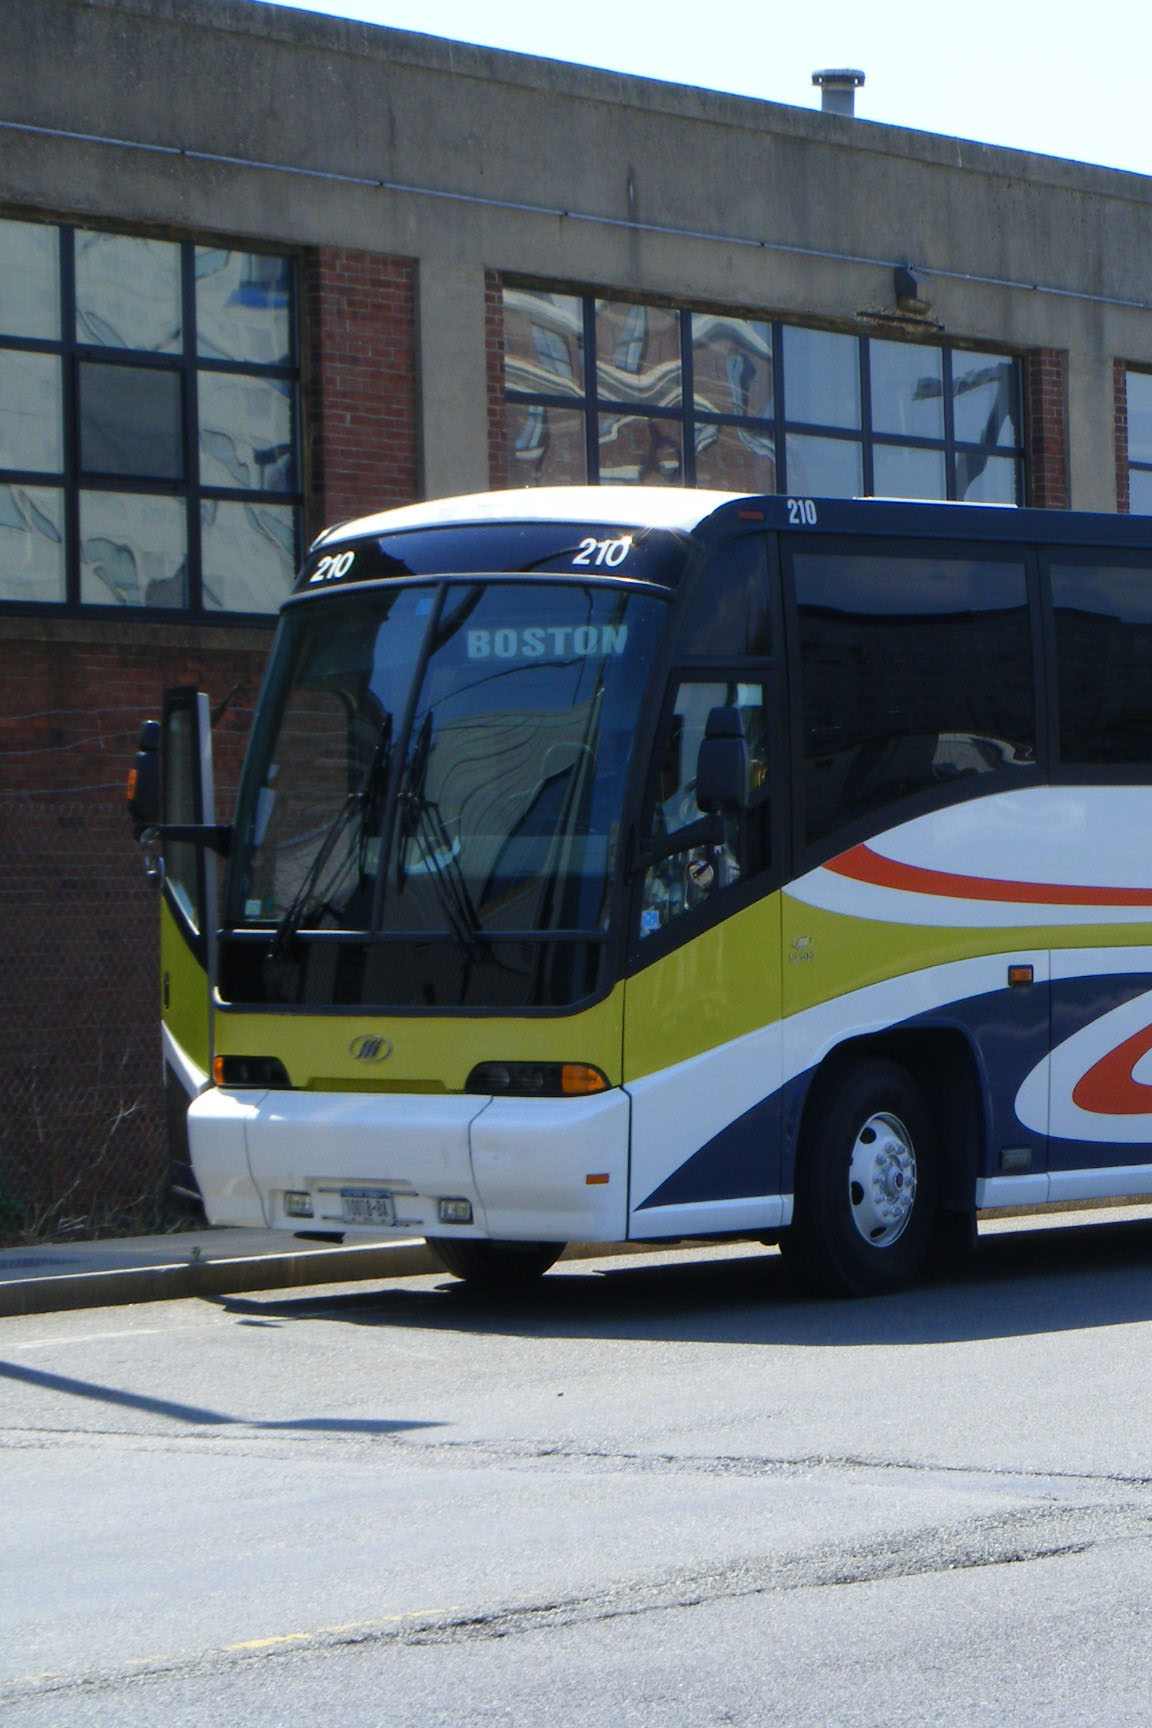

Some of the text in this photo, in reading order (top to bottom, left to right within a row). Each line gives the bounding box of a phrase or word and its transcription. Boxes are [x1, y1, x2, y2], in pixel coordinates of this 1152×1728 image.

[787, 499, 817, 525] 210
[310, 551, 354, 582] 210
[572, 536, 632, 567] 210
[467, 624, 628, 658] BOSTON
